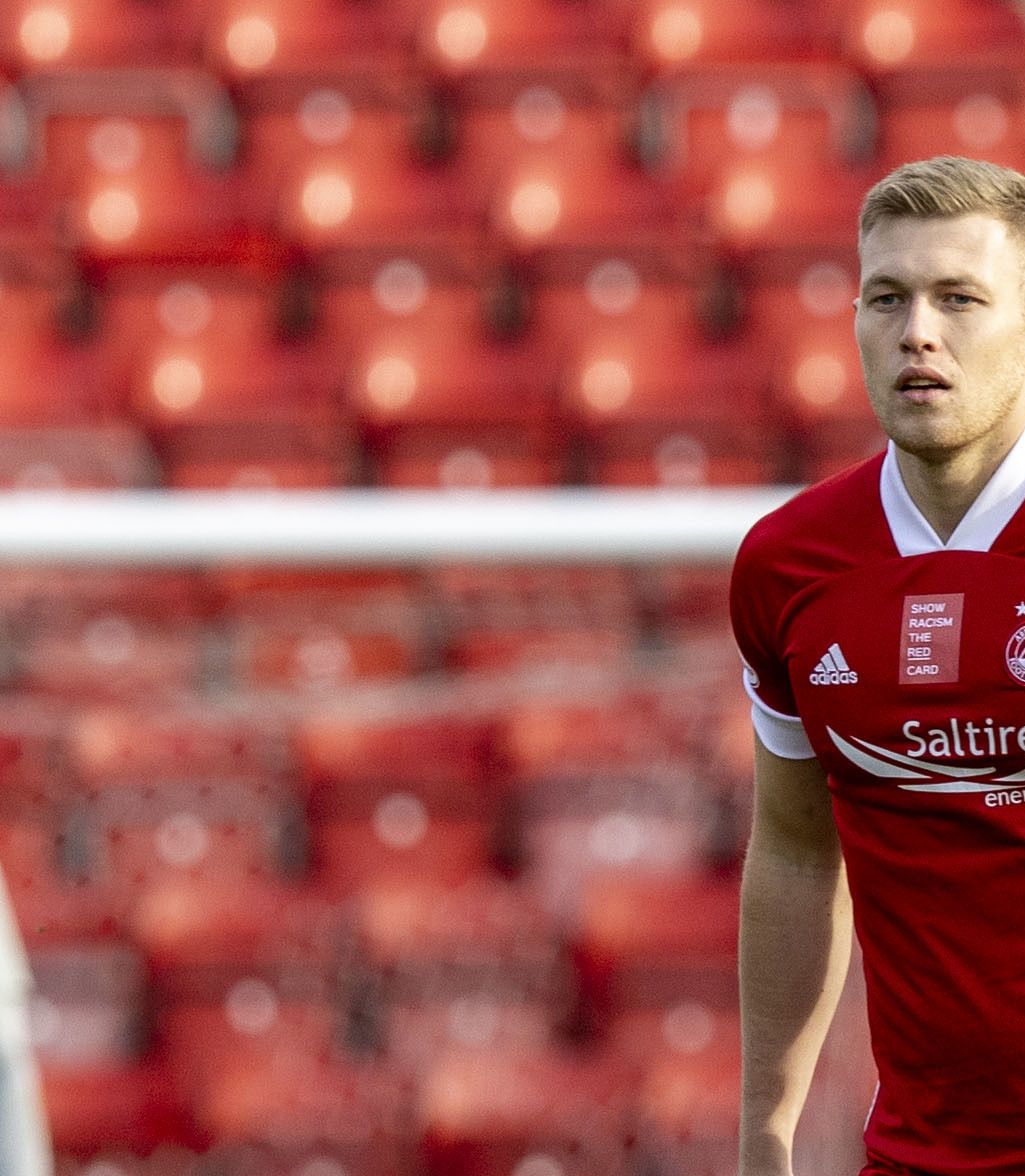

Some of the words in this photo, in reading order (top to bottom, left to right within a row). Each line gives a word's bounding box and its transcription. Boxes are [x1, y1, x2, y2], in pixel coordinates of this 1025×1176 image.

[911, 603, 946, 614] SHOW
[909, 617, 953, 628] RACISM
[909, 632, 932, 642] THE
[907, 647, 931, 657] RED
[906, 665, 940, 676] CARD
[809, 671, 858, 685] adidas
